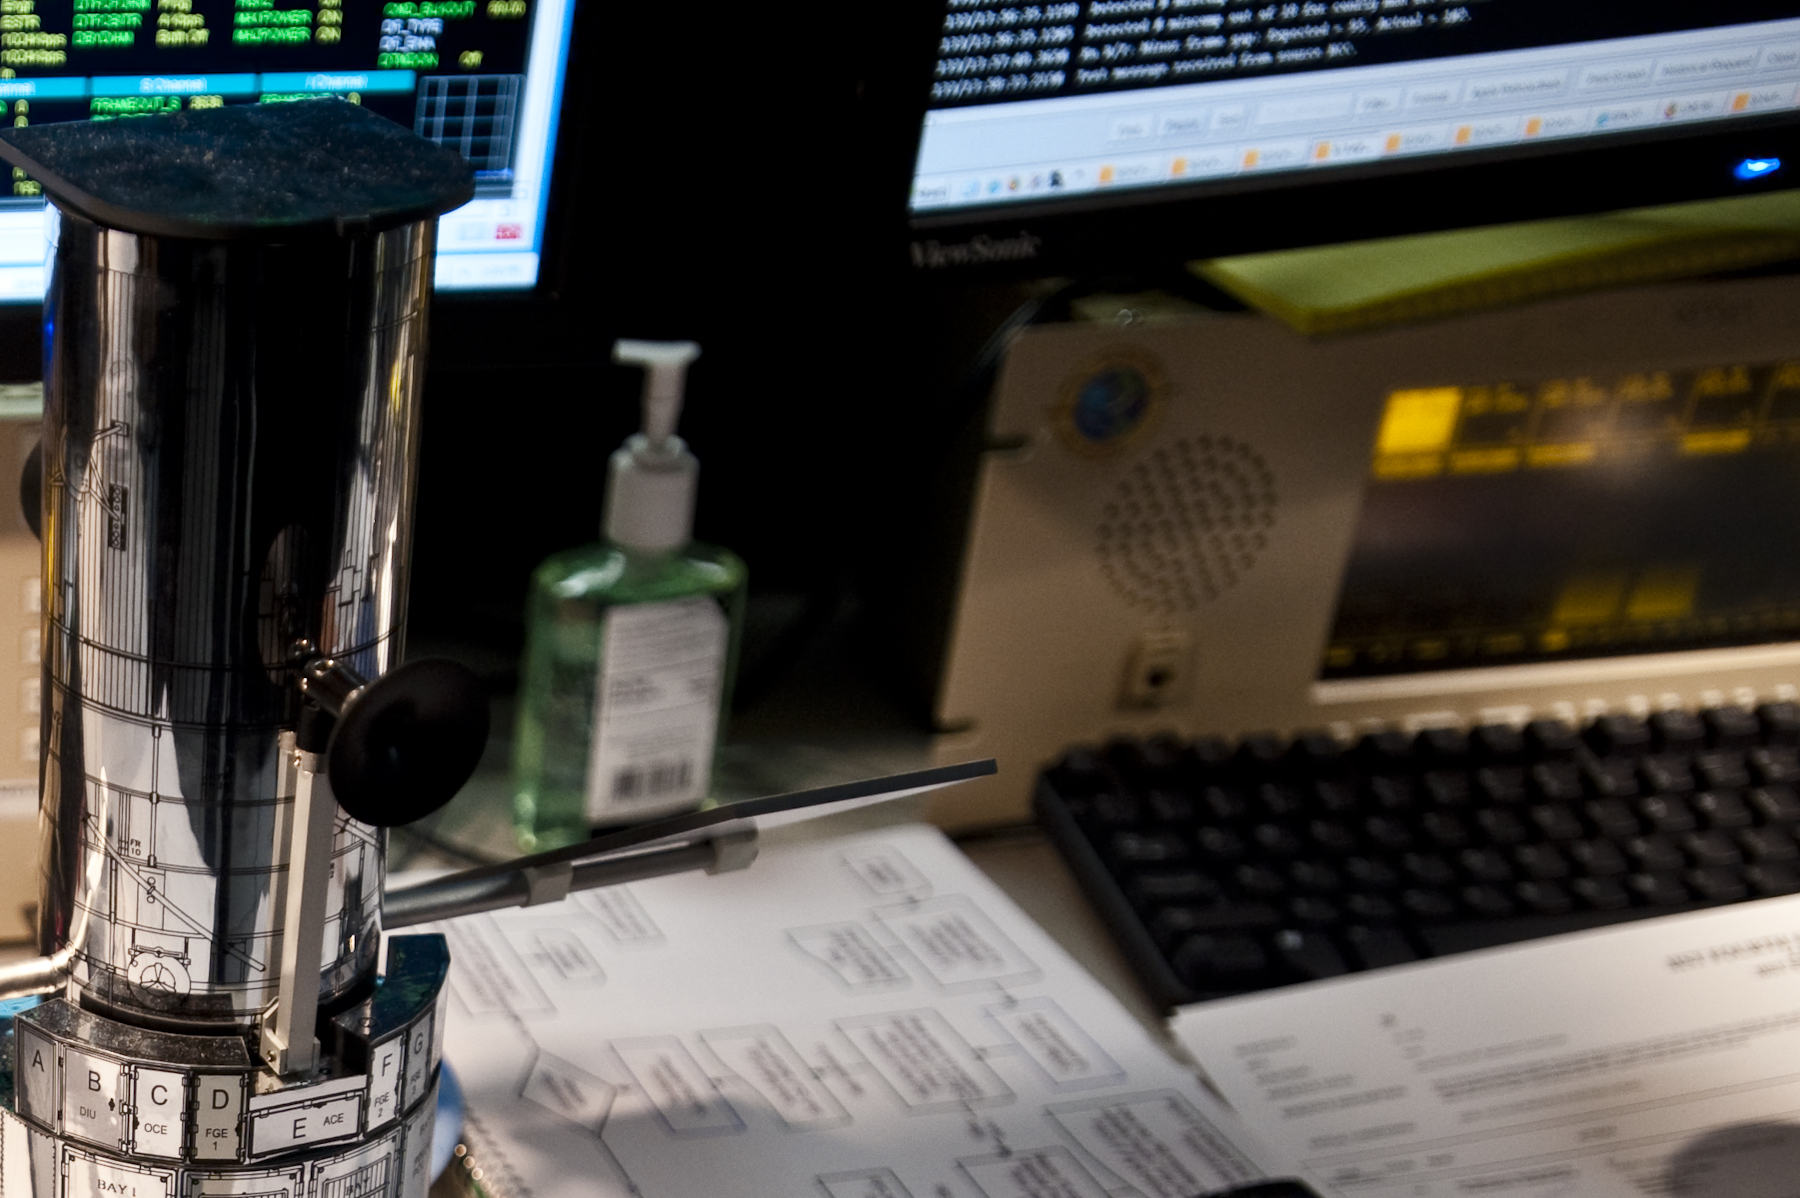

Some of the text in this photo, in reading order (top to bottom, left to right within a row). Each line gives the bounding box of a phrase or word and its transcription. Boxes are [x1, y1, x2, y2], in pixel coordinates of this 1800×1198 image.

[414, 1033, 422, 1054] G
[31, 1050, 46, 1072] A
[382, 1053, 392, 1076] F
[88, 1070, 101, 1091] B
[151, 1084, 167, 1105] C
[211, 1088, 229, 1109] D
[78, 1105, 96, 1119] DIU
[144, 1122, 167, 1135] OCE
[205, 1127, 228, 1138] FGE
[293, 1112, 344, 1139] E ACE
[97, 1178, 127, 1194] BAY
